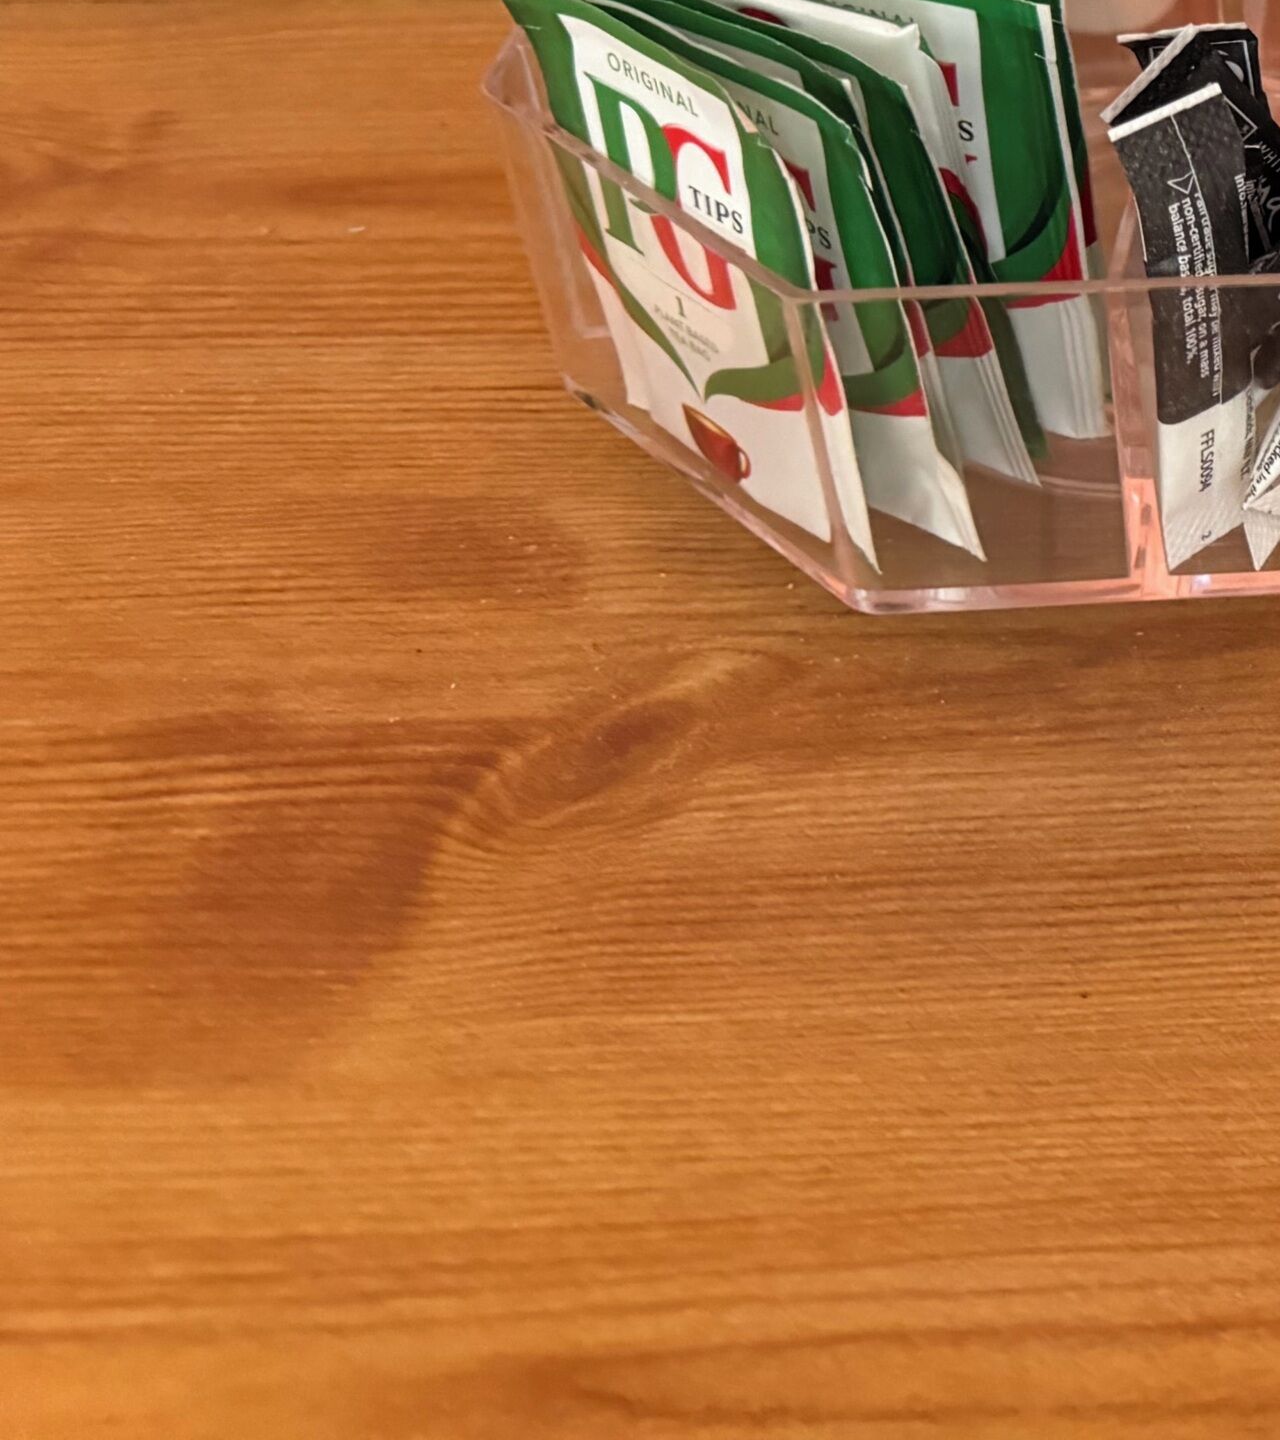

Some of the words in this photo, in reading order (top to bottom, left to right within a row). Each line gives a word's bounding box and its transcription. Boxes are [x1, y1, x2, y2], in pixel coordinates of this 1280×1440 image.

[606, 52, 699, 118] ORIGINAL
[583, 71, 737, 311] PG
[688, 185, 744, 235] TIPS
[1167, 203, 1188, 253] balance
[1180, 197, 1208, 278] non-certified
[1177, 254, 1190, 297] bas,
[675, 296, 686, 318] 1
[1182, 298, 1195, 327] total
[1184, 328, 1199, 365] 100%.
[1197, 322, 1207, 337] on
[1197, 350, 1209, 378] mass
